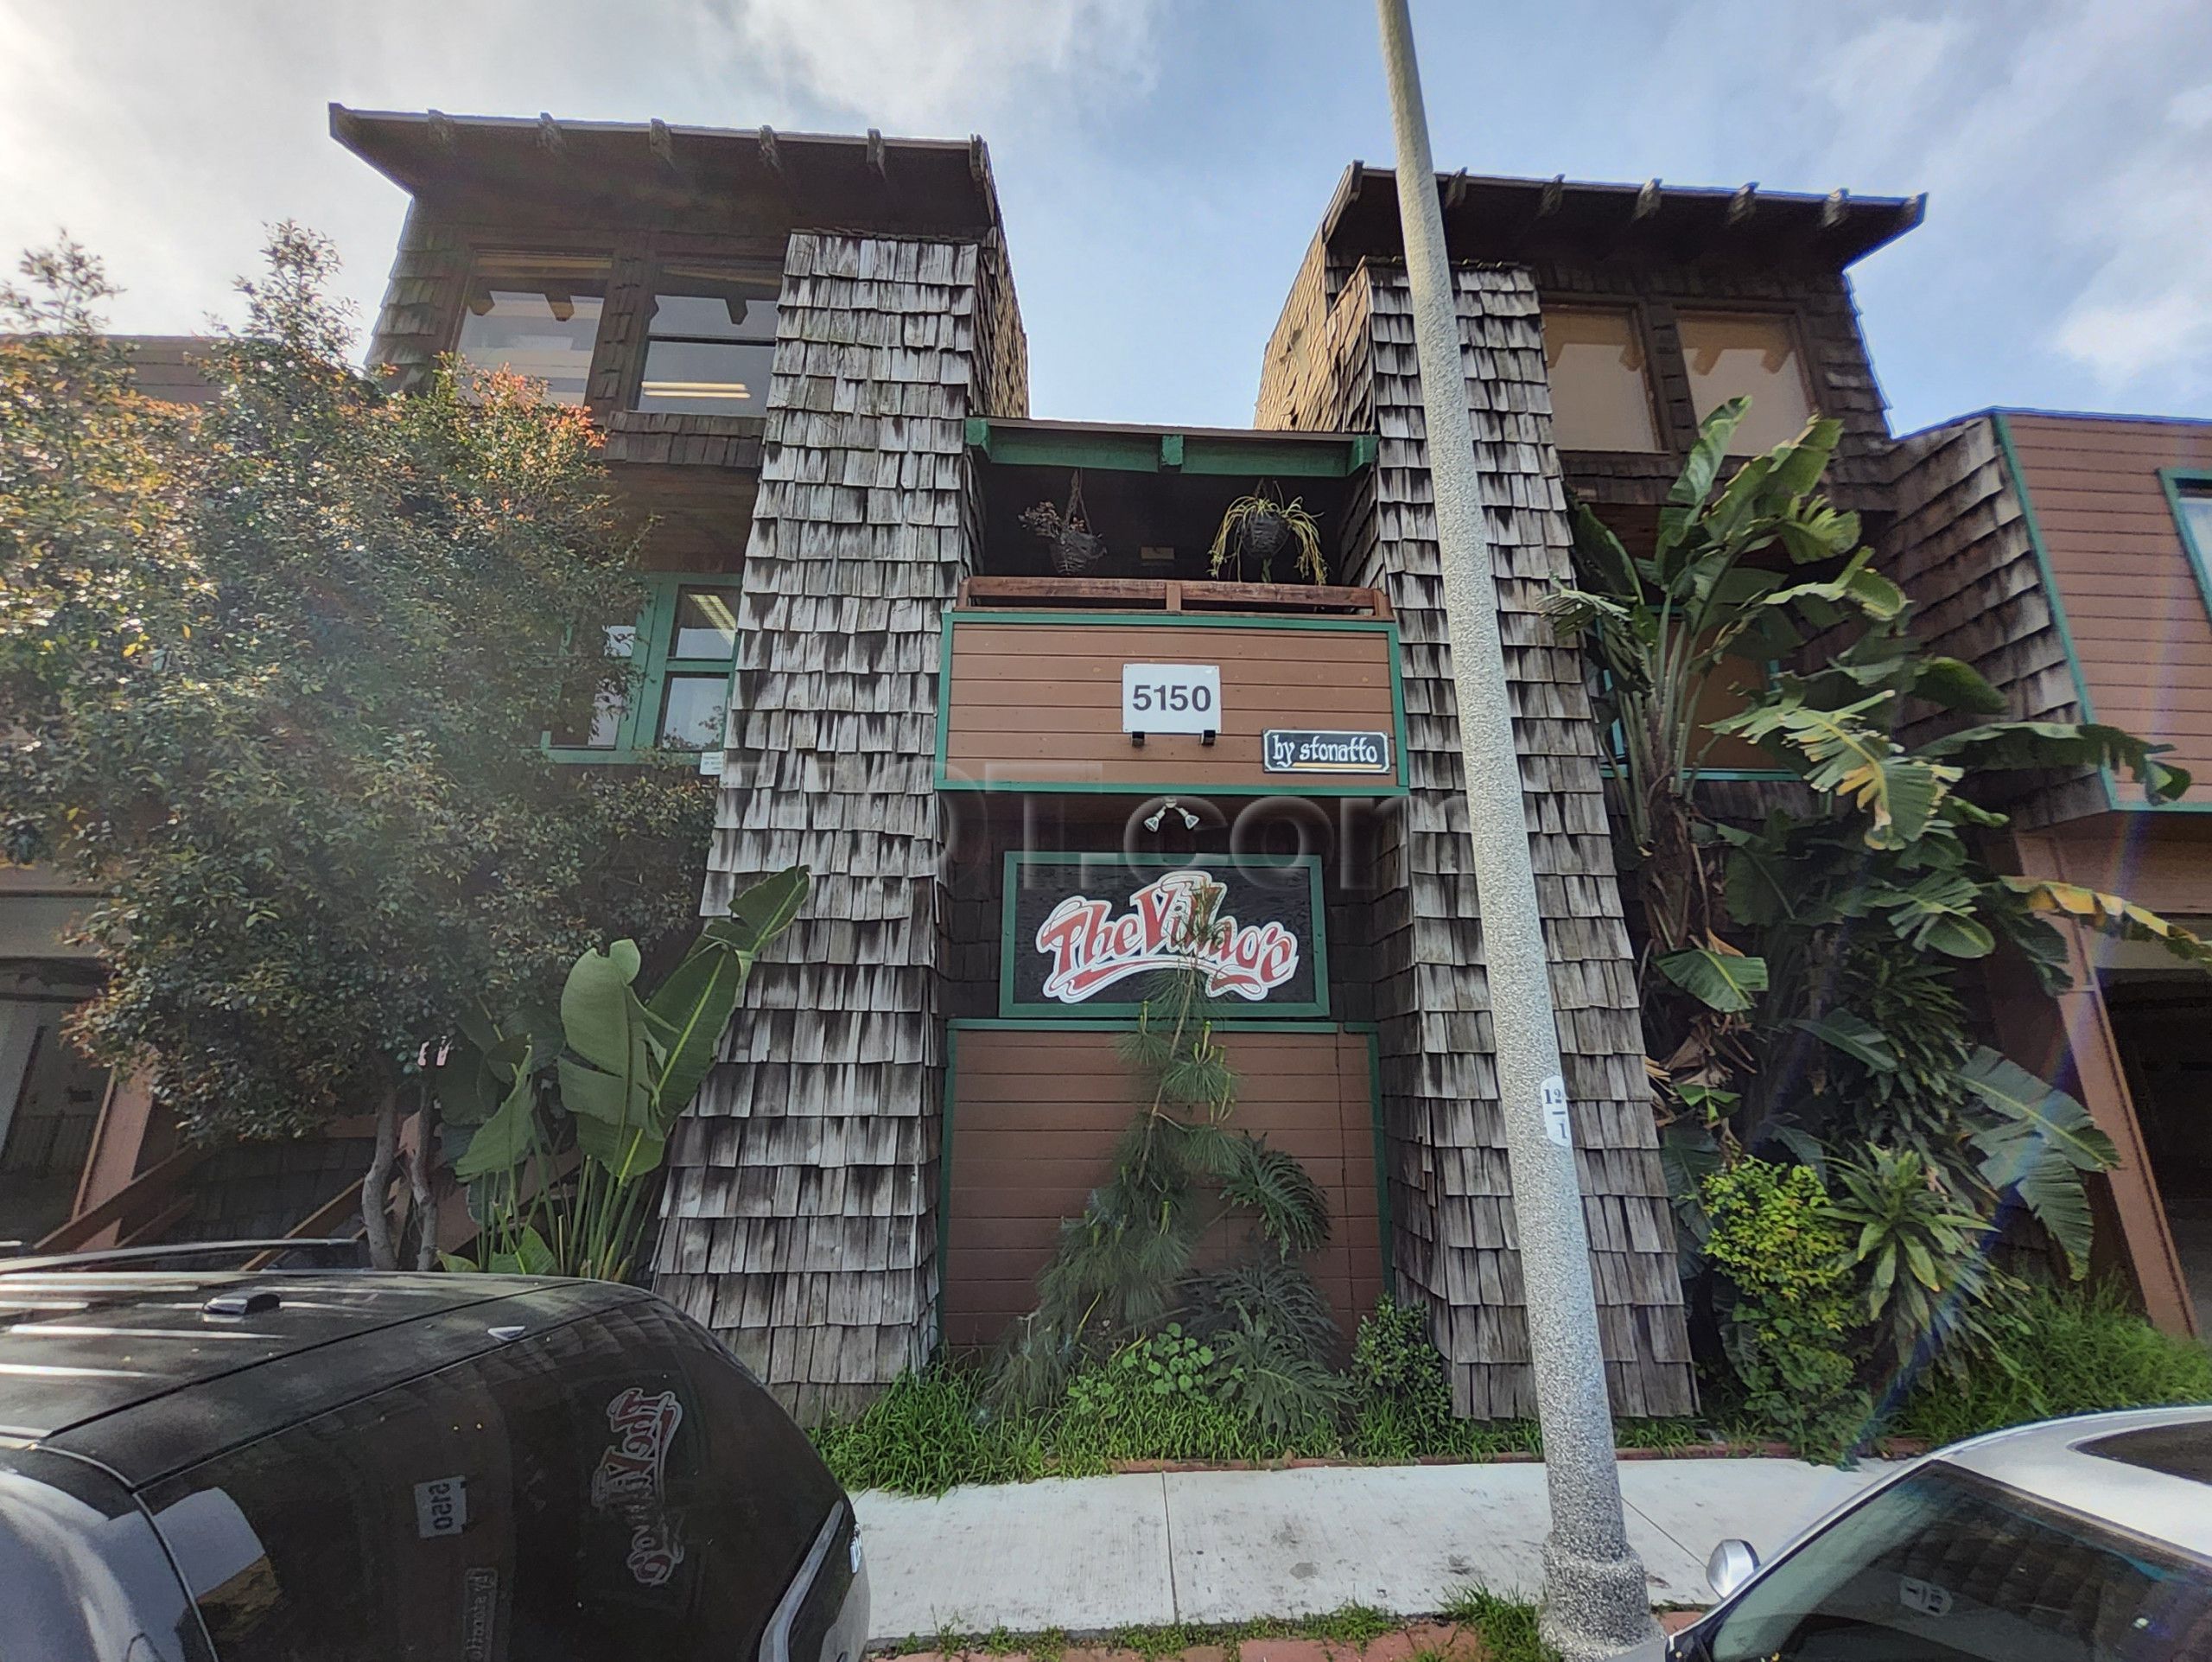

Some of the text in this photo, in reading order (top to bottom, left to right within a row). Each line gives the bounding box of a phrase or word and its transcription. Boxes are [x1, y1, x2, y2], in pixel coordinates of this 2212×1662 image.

[1131, 684, 1212, 712] 5150
[1271, 734, 1378, 767] by stonatto
[1036, 896, 1145, 985] The
